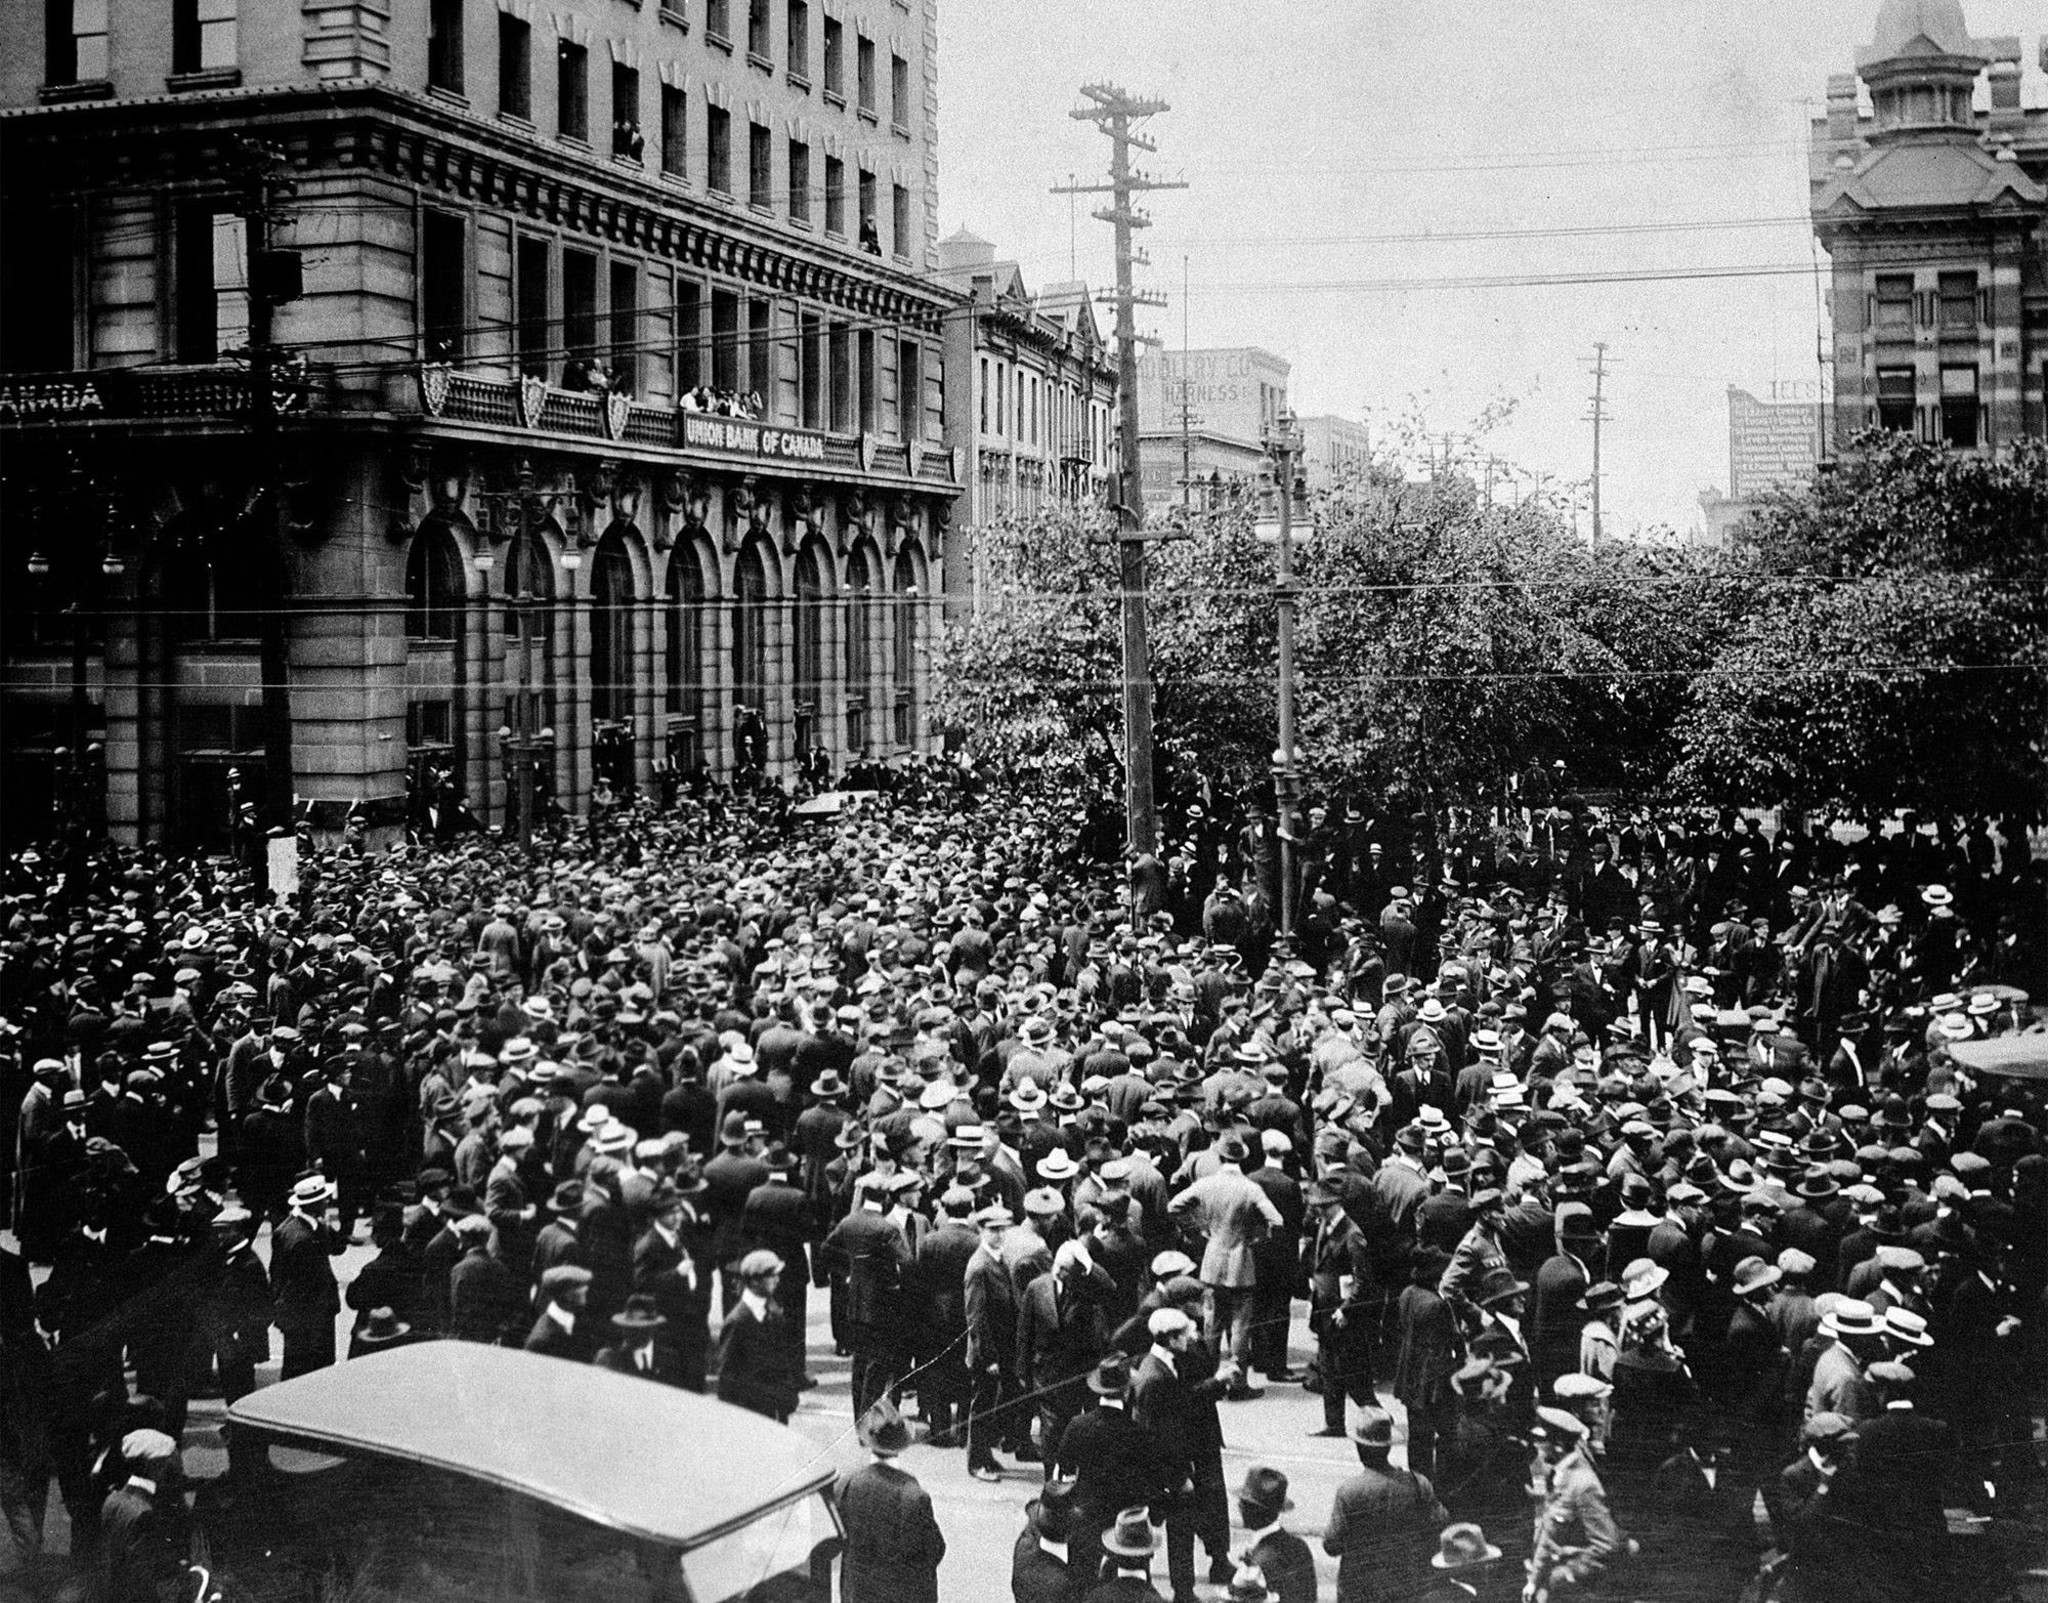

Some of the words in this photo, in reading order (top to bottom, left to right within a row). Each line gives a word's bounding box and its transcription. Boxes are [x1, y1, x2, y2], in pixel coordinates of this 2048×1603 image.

[1165, 385, 1239, 403] HARNESS
[687, 418, 725, 447] UNION
[726, 425, 759, 451] BANK
[762, 430, 780, 454] OF
[781, 433, 824, 458] CANADA
